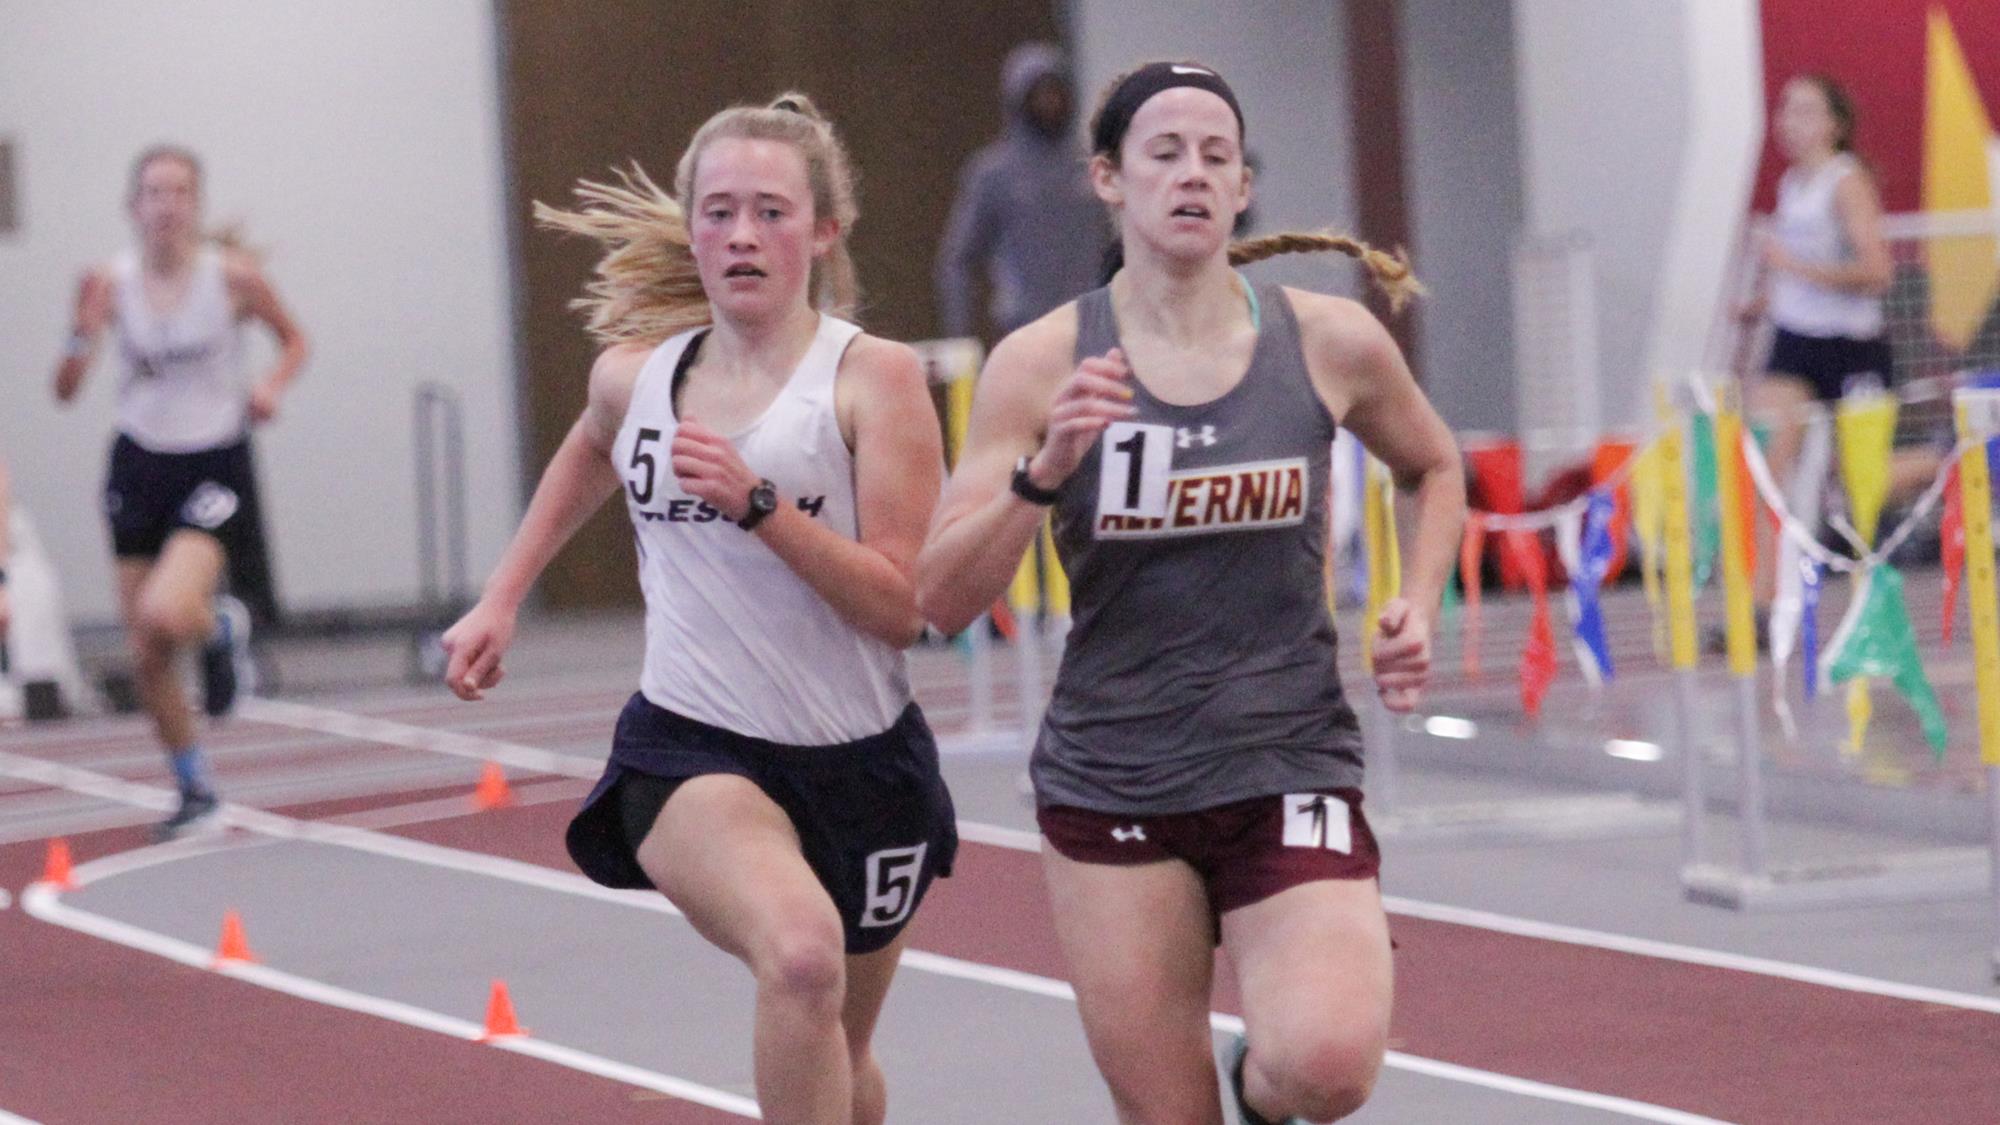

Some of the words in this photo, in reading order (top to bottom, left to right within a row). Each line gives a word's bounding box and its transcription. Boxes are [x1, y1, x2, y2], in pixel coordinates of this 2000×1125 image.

[629, 427, 662, 505] 5
[1099, 466, 1301, 531] ERNIA
[1115, 431, 1146, 509] 1
[1297, 795, 1328, 850] 1
[874, 854, 916, 922] 5
